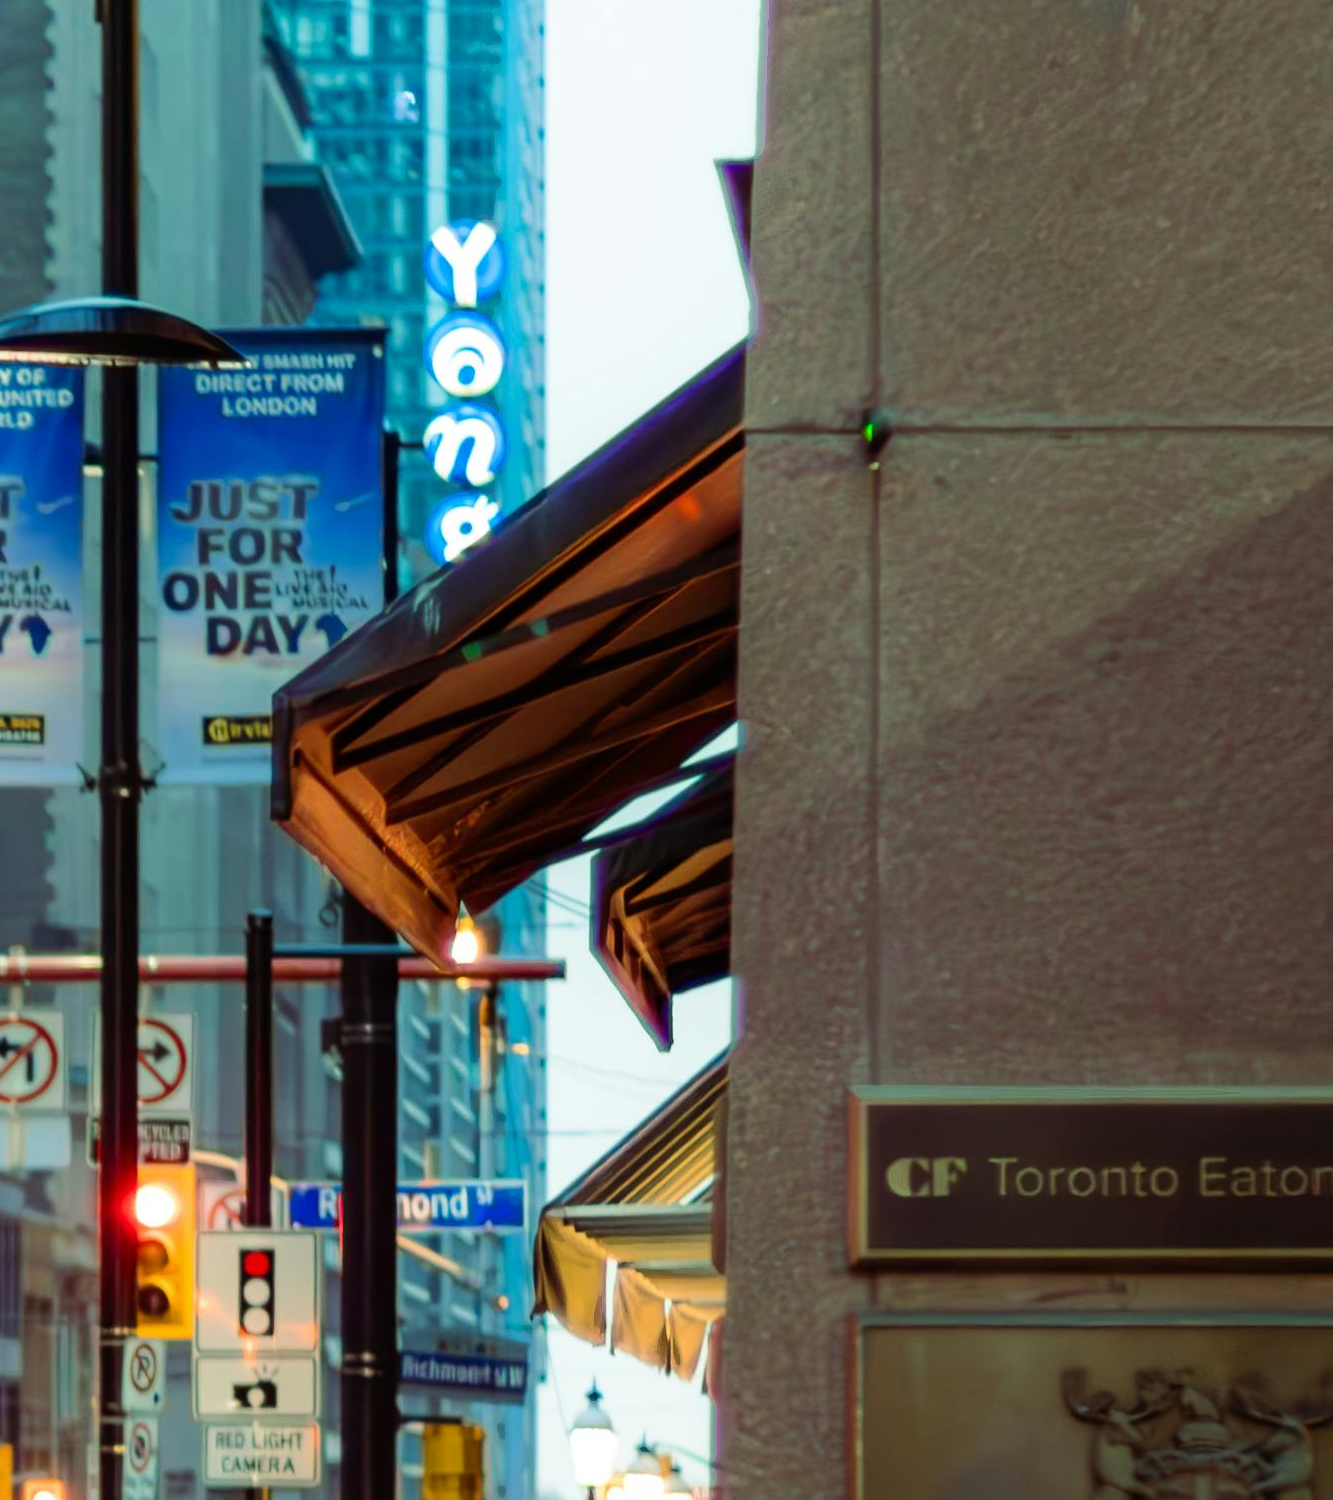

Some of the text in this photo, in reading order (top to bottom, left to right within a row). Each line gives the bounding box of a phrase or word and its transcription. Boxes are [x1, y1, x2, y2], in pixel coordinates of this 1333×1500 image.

[263, 354, 324, 369] SMASH
[327, 353, 357, 369] HIT
[16, 368, 47, 386] OF
[195, 372, 345, 393] DIRECT FROM
[222, 396, 318, 416] LONDON
[170, 478, 318, 523] JUST
[197, 527, 303, 565] FOR
[163, 571, 272, 611] ONE
[206, 615, 309, 655] DAY
[885, 1157, 967, 1197] CF
[988, 1157, 1179, 1197] Toronto
[402, 1355, 491, 1384] Richmond
[215, 1431, 302, 1449] RED LIGHT
[221, 1456, 295, 1474] CAMERA
